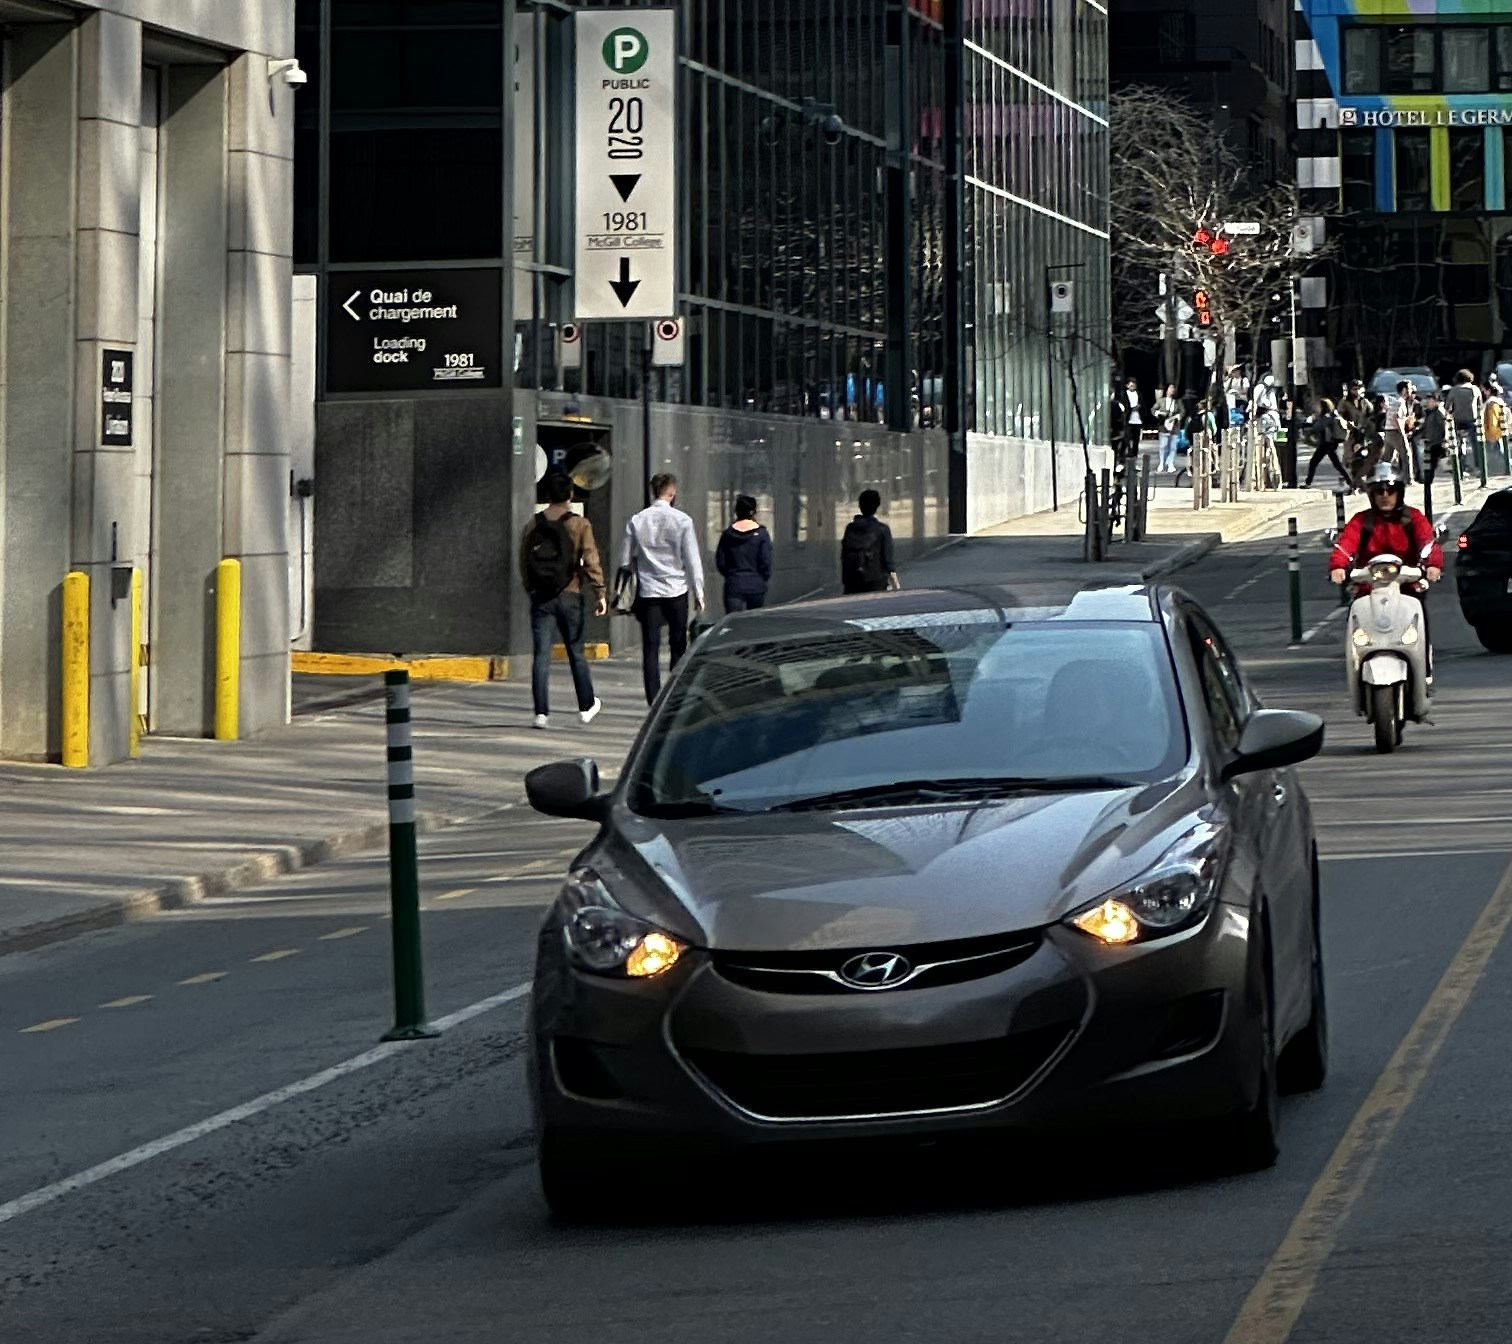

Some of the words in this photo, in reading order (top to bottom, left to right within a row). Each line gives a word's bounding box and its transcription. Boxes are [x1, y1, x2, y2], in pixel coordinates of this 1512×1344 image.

[615, 35, 641, 69] P
[602, 79, 650, 90] PUBLIC
[608, 97, 643, 134] 20
[1437, 110, 1457, 125] LE
[603, 212, 647, 231] 1981
[370, 289, 408, 304] Quai
[412, 289, 432, 303] de
[369, 305, 457, 322] chargement
[373, 337, 426, 352] Loading
[373, 351, 408, 363] dock
[444, 353, 474, 367] 1981
